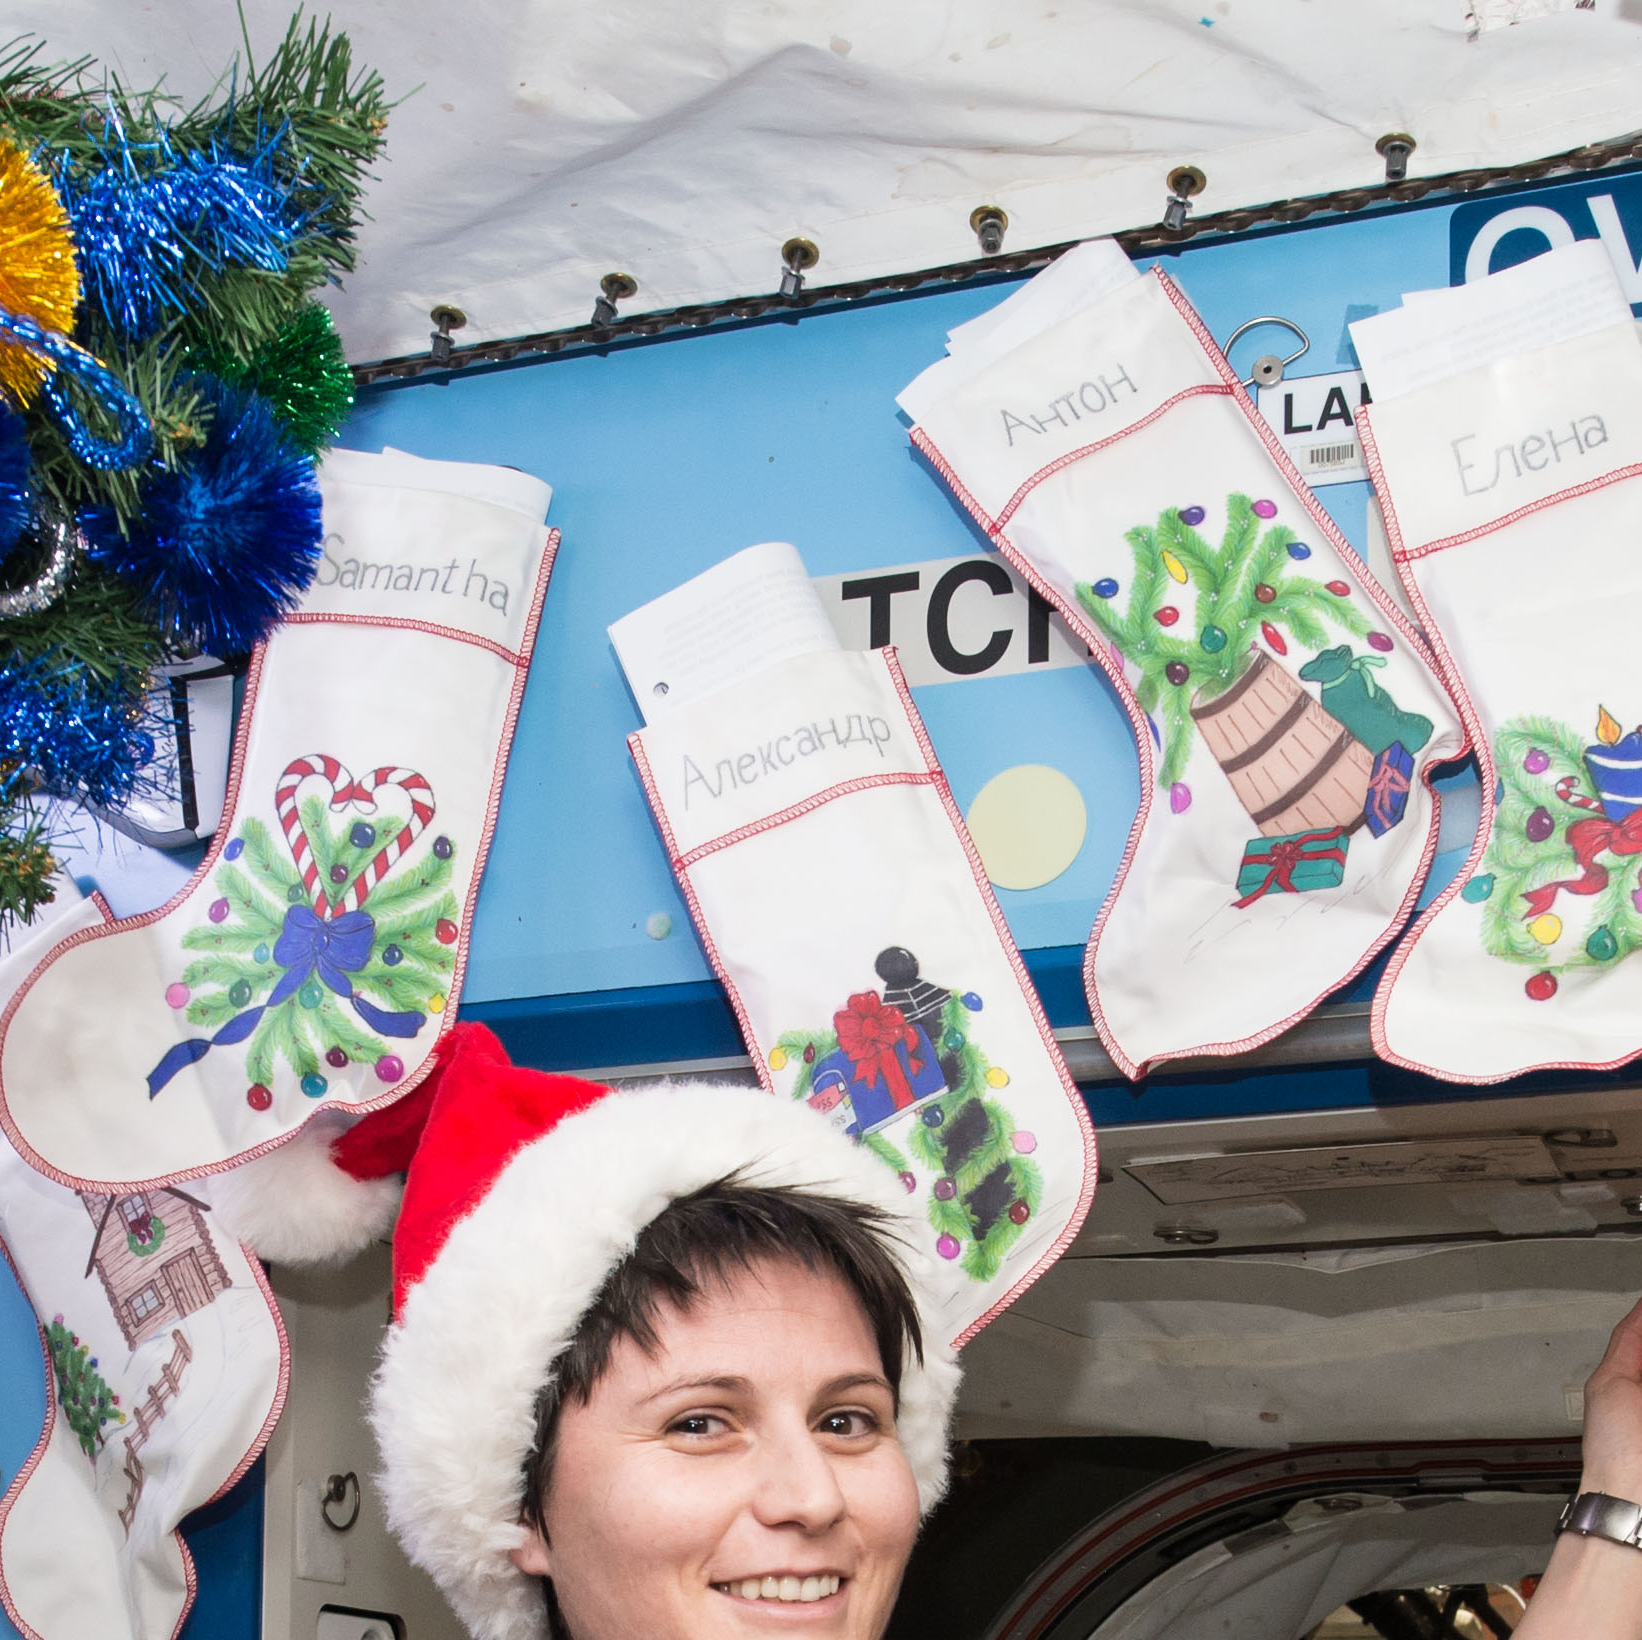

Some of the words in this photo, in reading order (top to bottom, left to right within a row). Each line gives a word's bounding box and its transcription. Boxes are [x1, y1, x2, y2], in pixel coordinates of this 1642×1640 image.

[1000, 363, 1137, 447] Антон
[1451, 414, 1610, 496] Елена
[318, 532, 510, 617] Samantha
[680, 712, 892, 811] Александр
